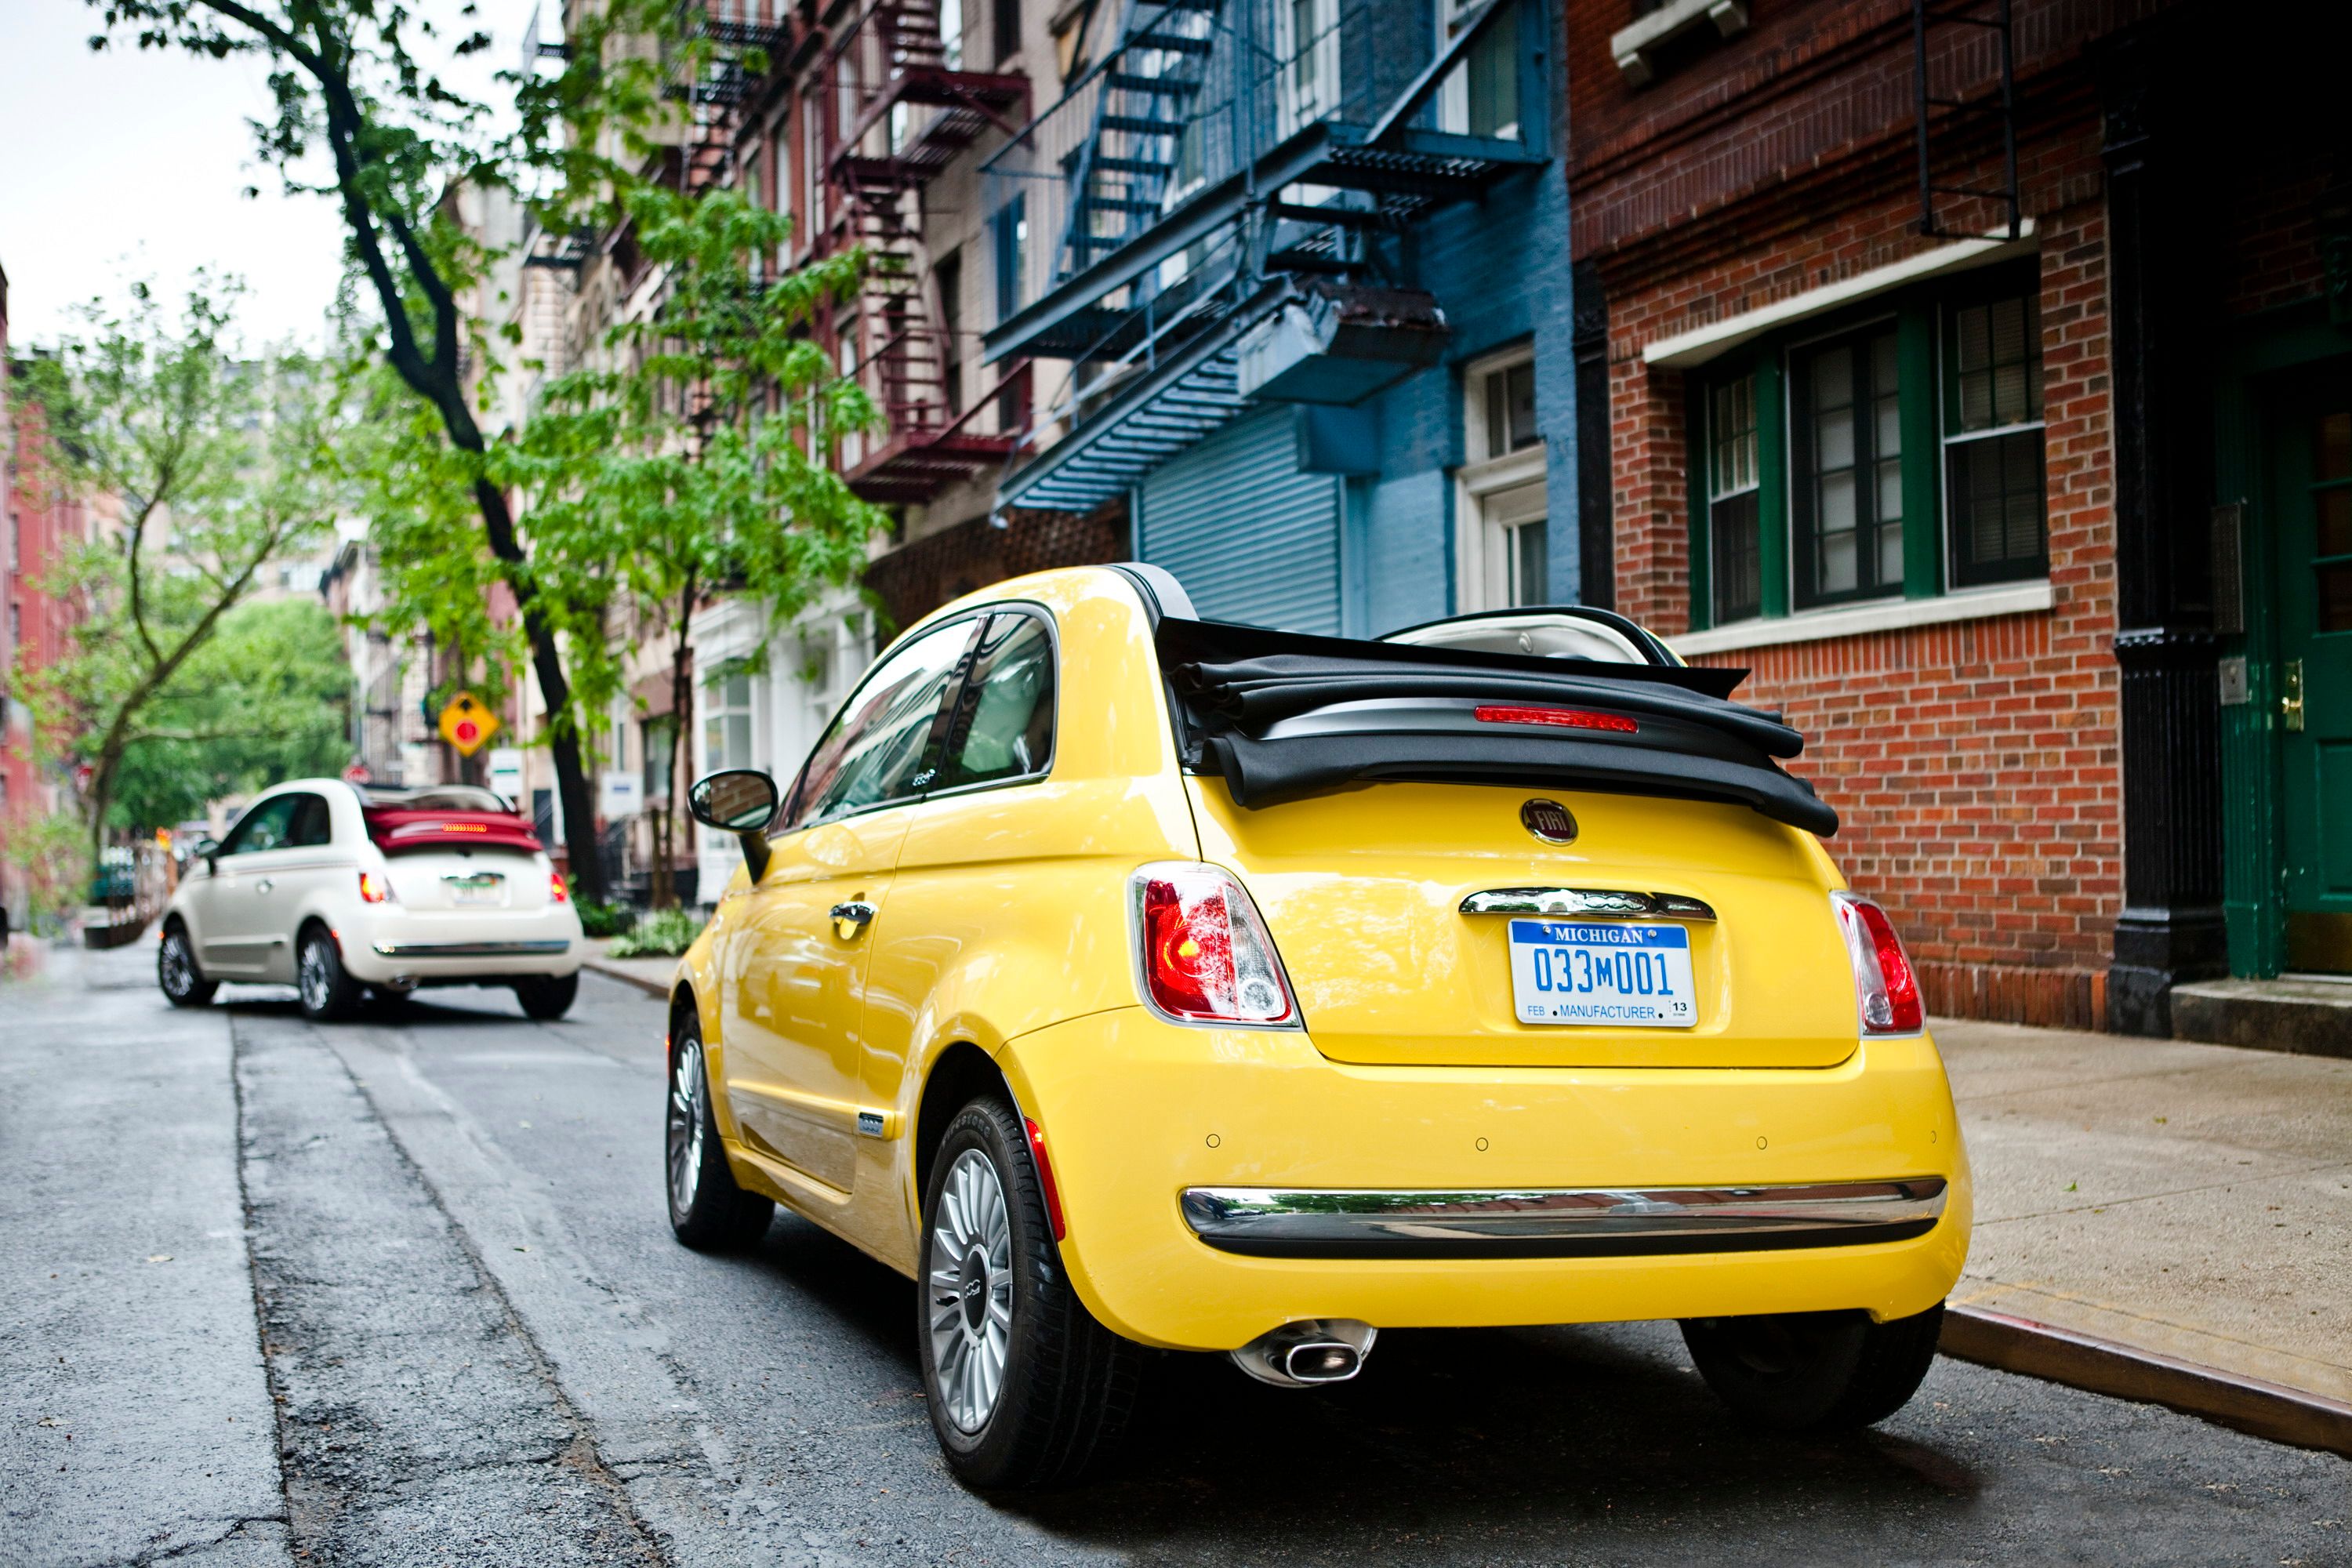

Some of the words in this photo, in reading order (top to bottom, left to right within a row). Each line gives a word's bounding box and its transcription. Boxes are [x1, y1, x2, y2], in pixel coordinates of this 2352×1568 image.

[1533, 809, 1569, 831] FIAT
[1555, 927, 1643, 943] MICHIGAN
[1534, 948, 1674, 996] 033M001
[1527, 1005, 1545, 1016] FEB
[1560, 1004, 1656, 1018] MANUFACTURER
[1672, 1002, 1687, 1011] 13
